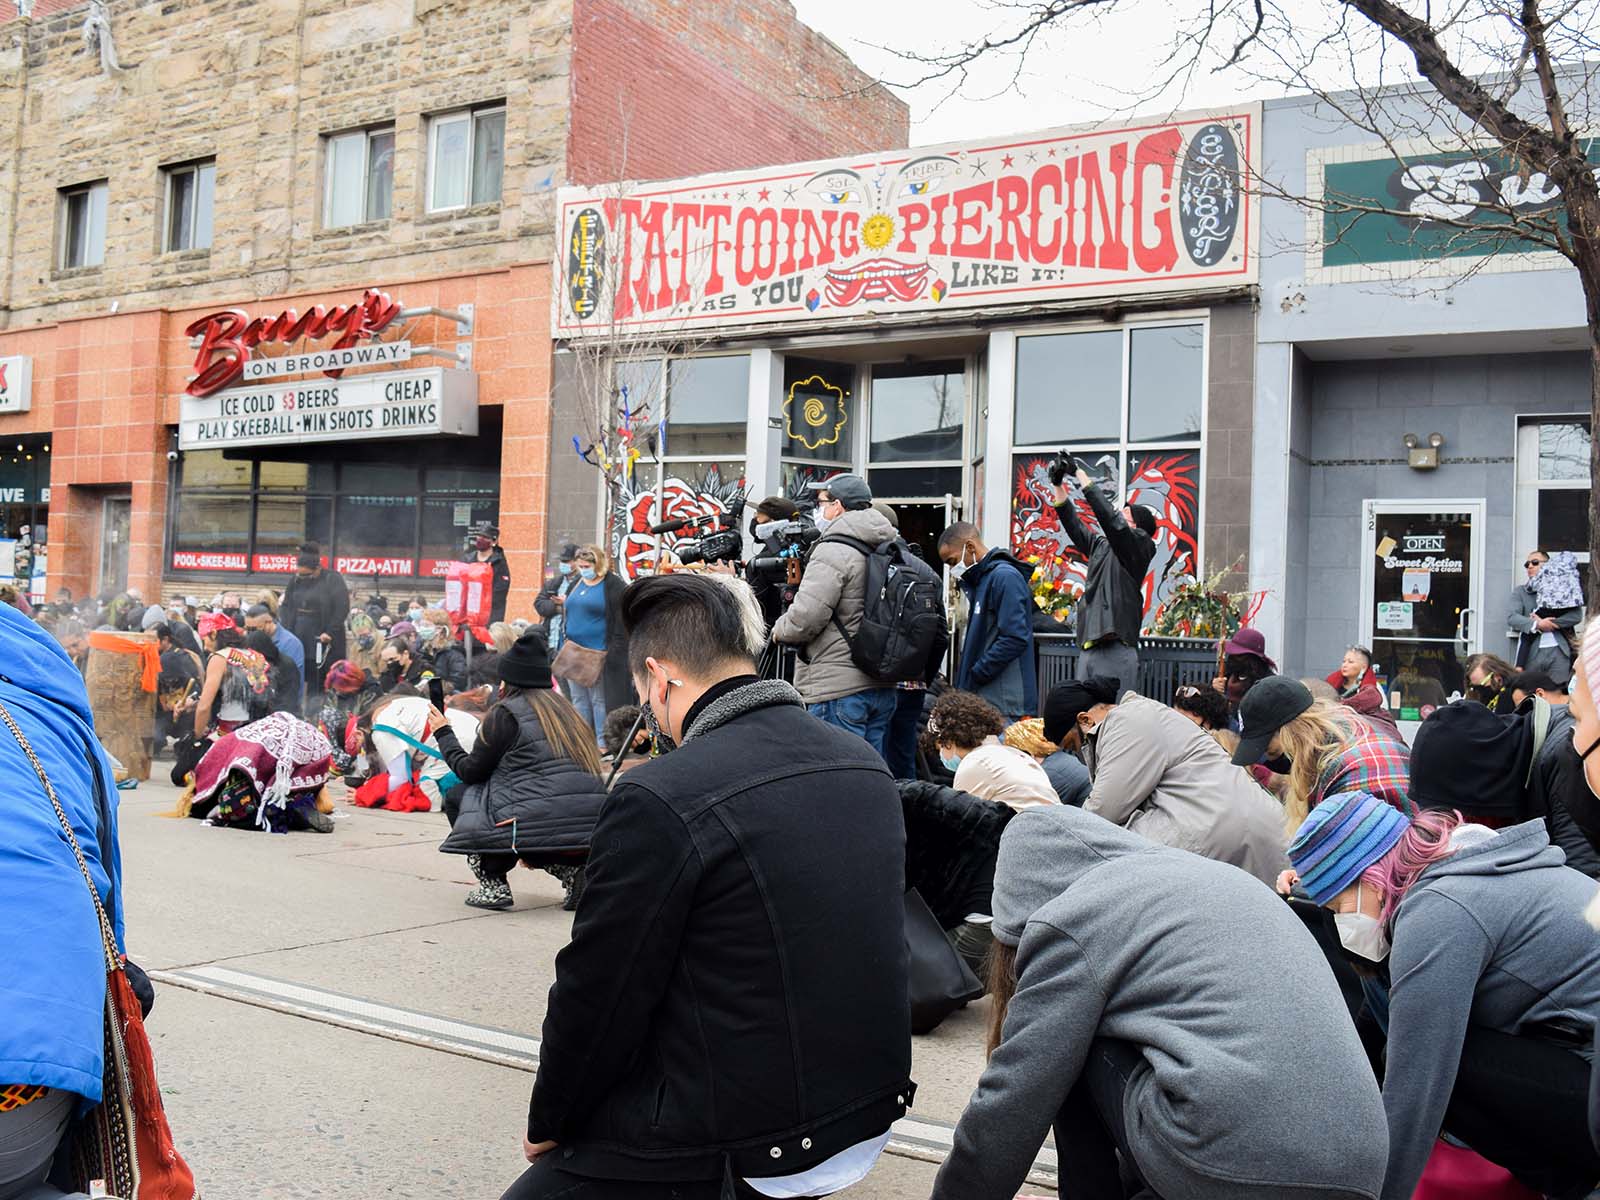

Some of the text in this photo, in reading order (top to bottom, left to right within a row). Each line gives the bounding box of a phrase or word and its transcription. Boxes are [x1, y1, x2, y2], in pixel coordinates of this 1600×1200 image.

[602, 126, 1182, 321] TATTOOING PIERCING
[575, 214, 599, 313] ELECTRIC
[752, 276, 804, 305] YOU
[951, 262, 1018, 288] LIKE
[1031, 268, 1065, 281] IT!
[220, 379, 432, 416] ICE COLD $3 BEERS CHEAP
[198, 421, 229, 440] PLAY
[330, 410, 373, 429] SHOTS
[382, 404, 437, 426] DRINKS
[1406, 538, 1443, 549] OPEN
[1384, 556, 1463, 569] Sweet Action
